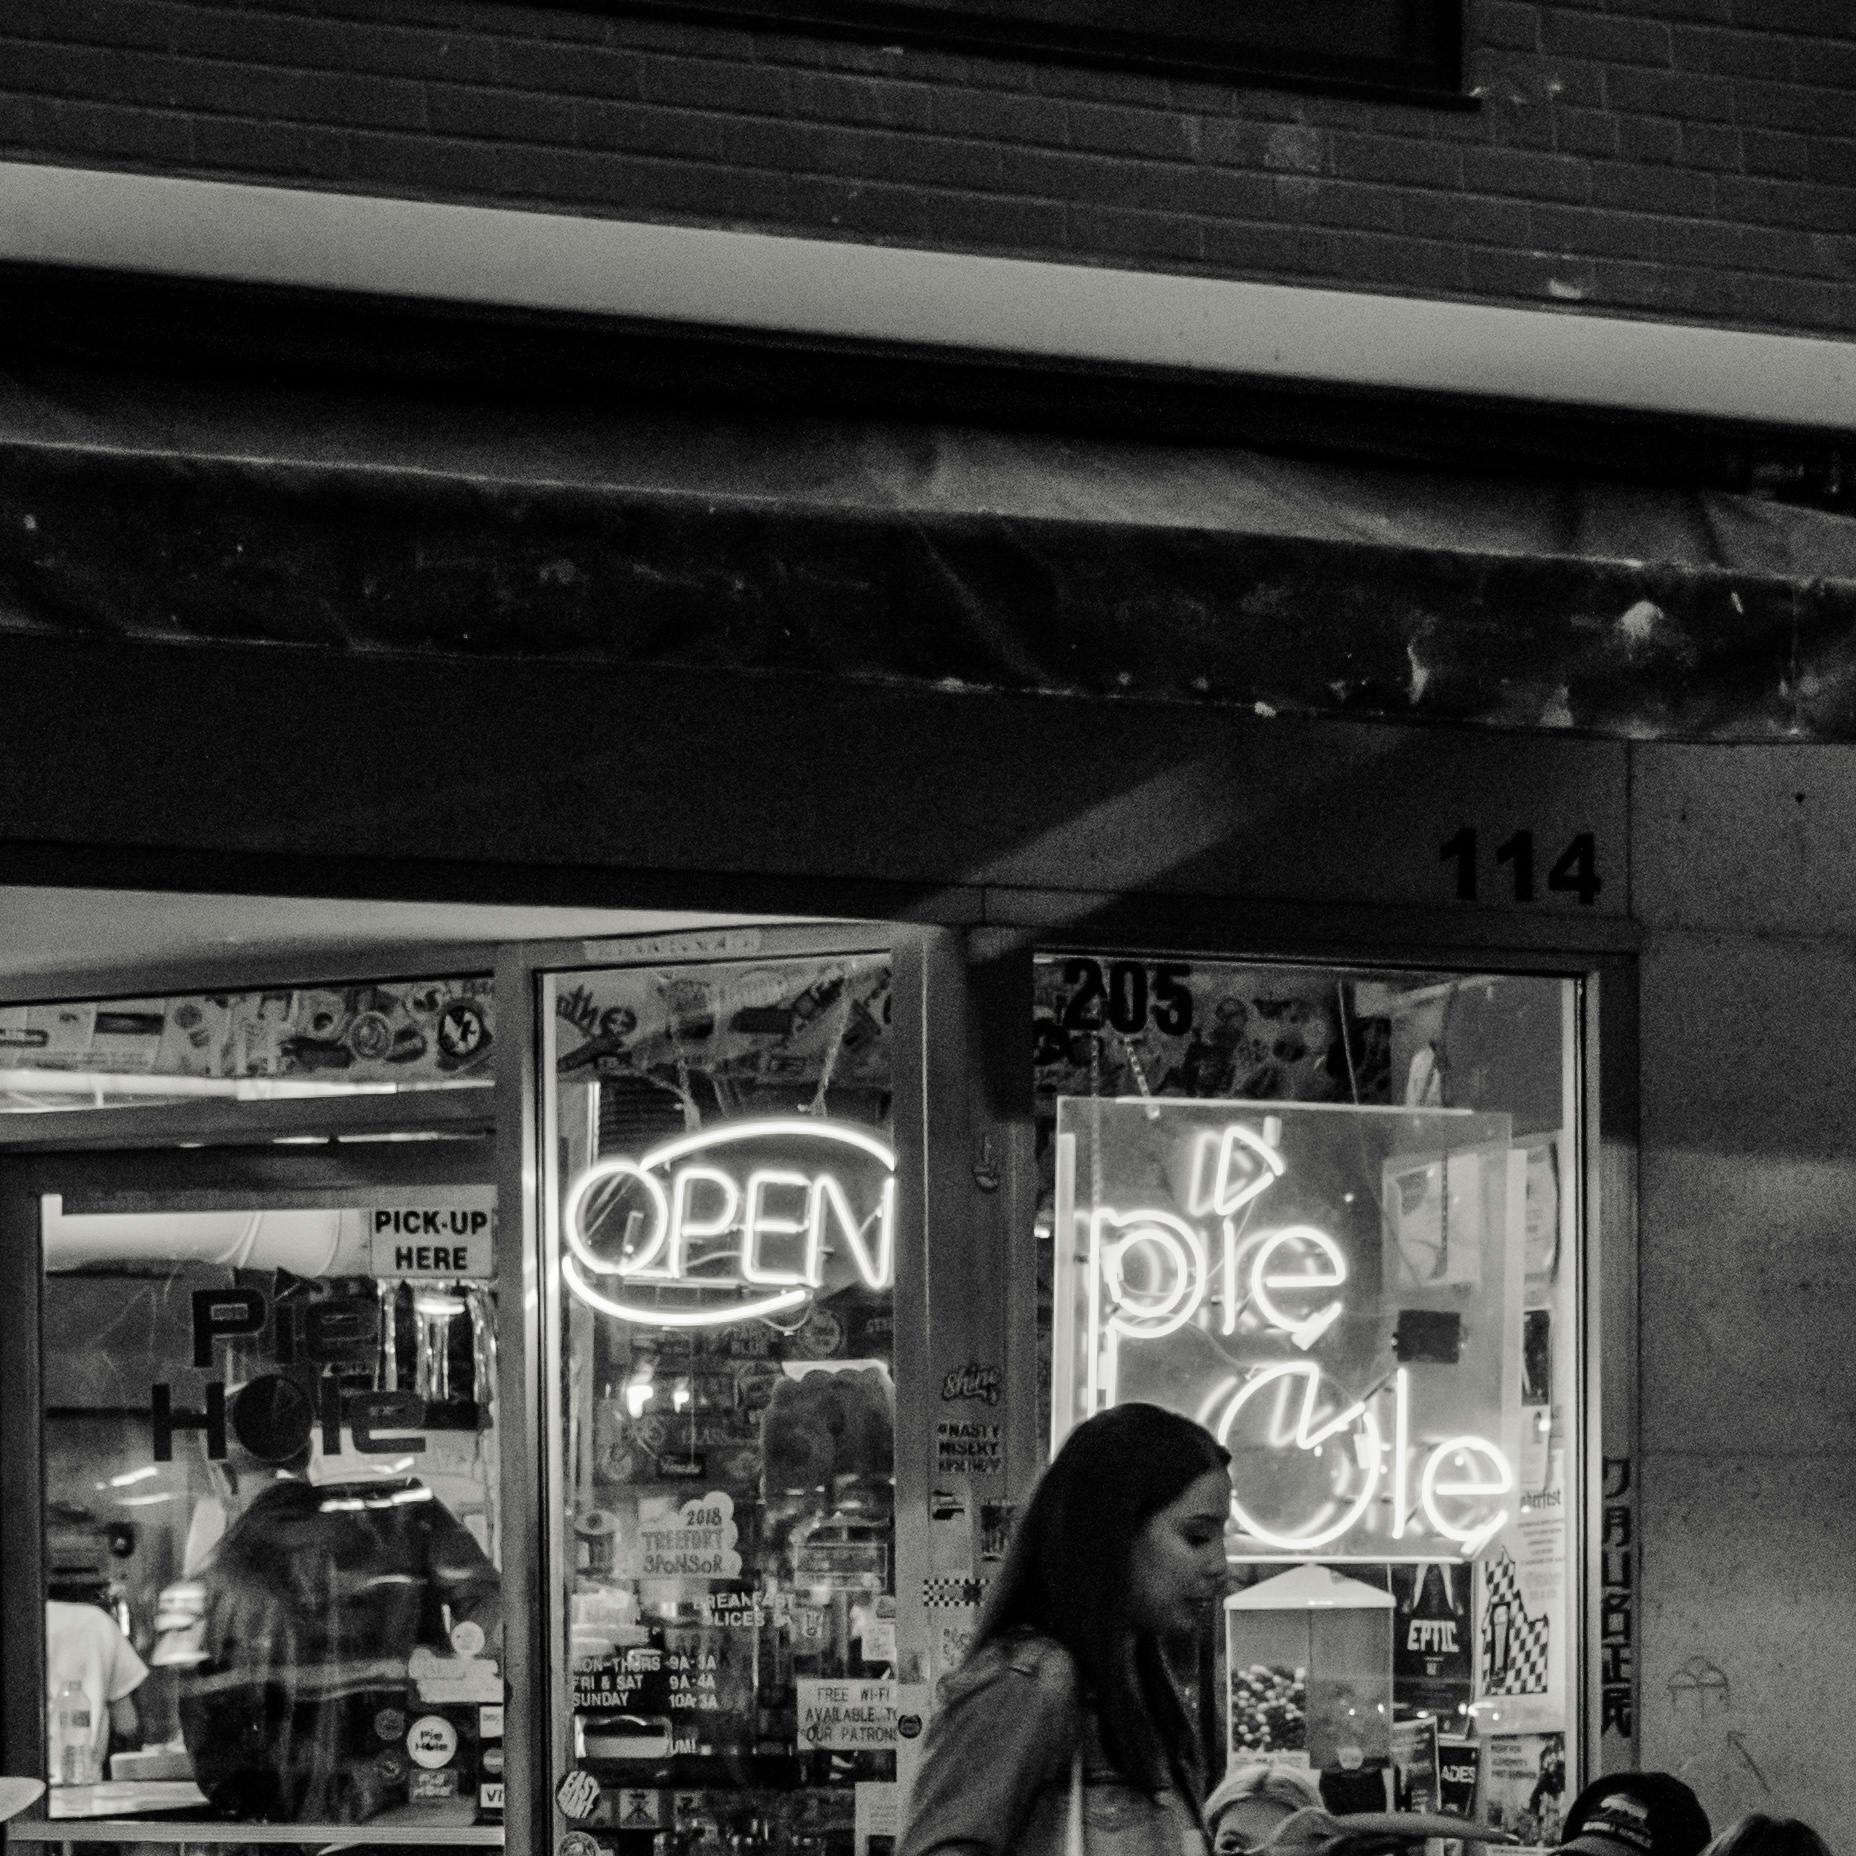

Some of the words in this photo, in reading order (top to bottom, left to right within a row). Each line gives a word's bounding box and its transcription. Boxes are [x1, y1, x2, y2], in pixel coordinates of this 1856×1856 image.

[1440, 828, 1601, 904] 114
[1063, 958, 1193, 1035] 205
[374, 1210, 488, 1236] PICK-UP
[564, 1159, 896, 1290] OPEN
[395, 1246, 468, 1271] HERE
[686, 1506, 723, 1526] 2018
[616, 1674, 644, 1690] SAT
[571, 1691, 630, 1707] SUNDAY
[817, 1687, 849, 1702] FREE
[805, 1706, 875, 1723] AVAILABLE
[806, 1726, 832, 1742] OUR
